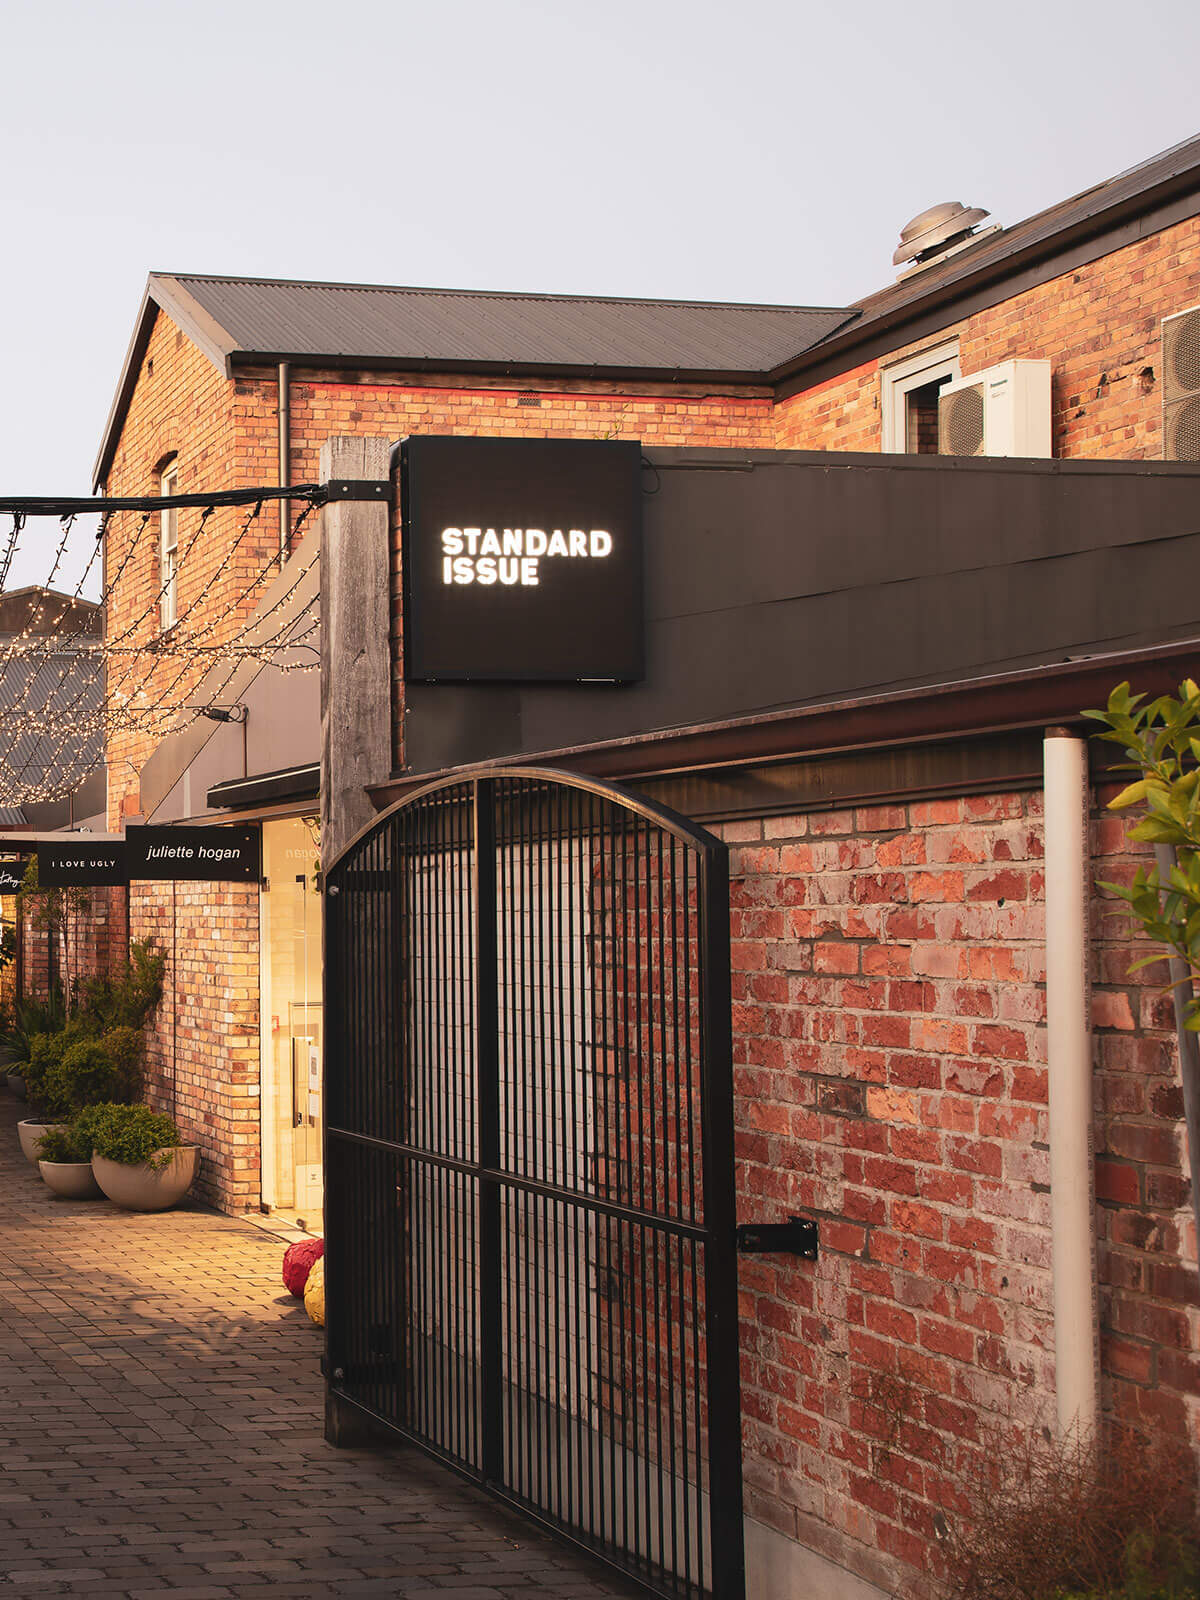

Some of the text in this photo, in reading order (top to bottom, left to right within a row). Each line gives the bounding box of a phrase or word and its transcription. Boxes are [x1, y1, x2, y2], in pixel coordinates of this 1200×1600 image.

[441, 527, 612, 557] STANDARD
[443, 557, 539, 586] ISSUE
[59, 860, 86, 868] LOVE
[89, 860, 116, 868] UGLY
[145, 845, 241, 862] juliette hogan
